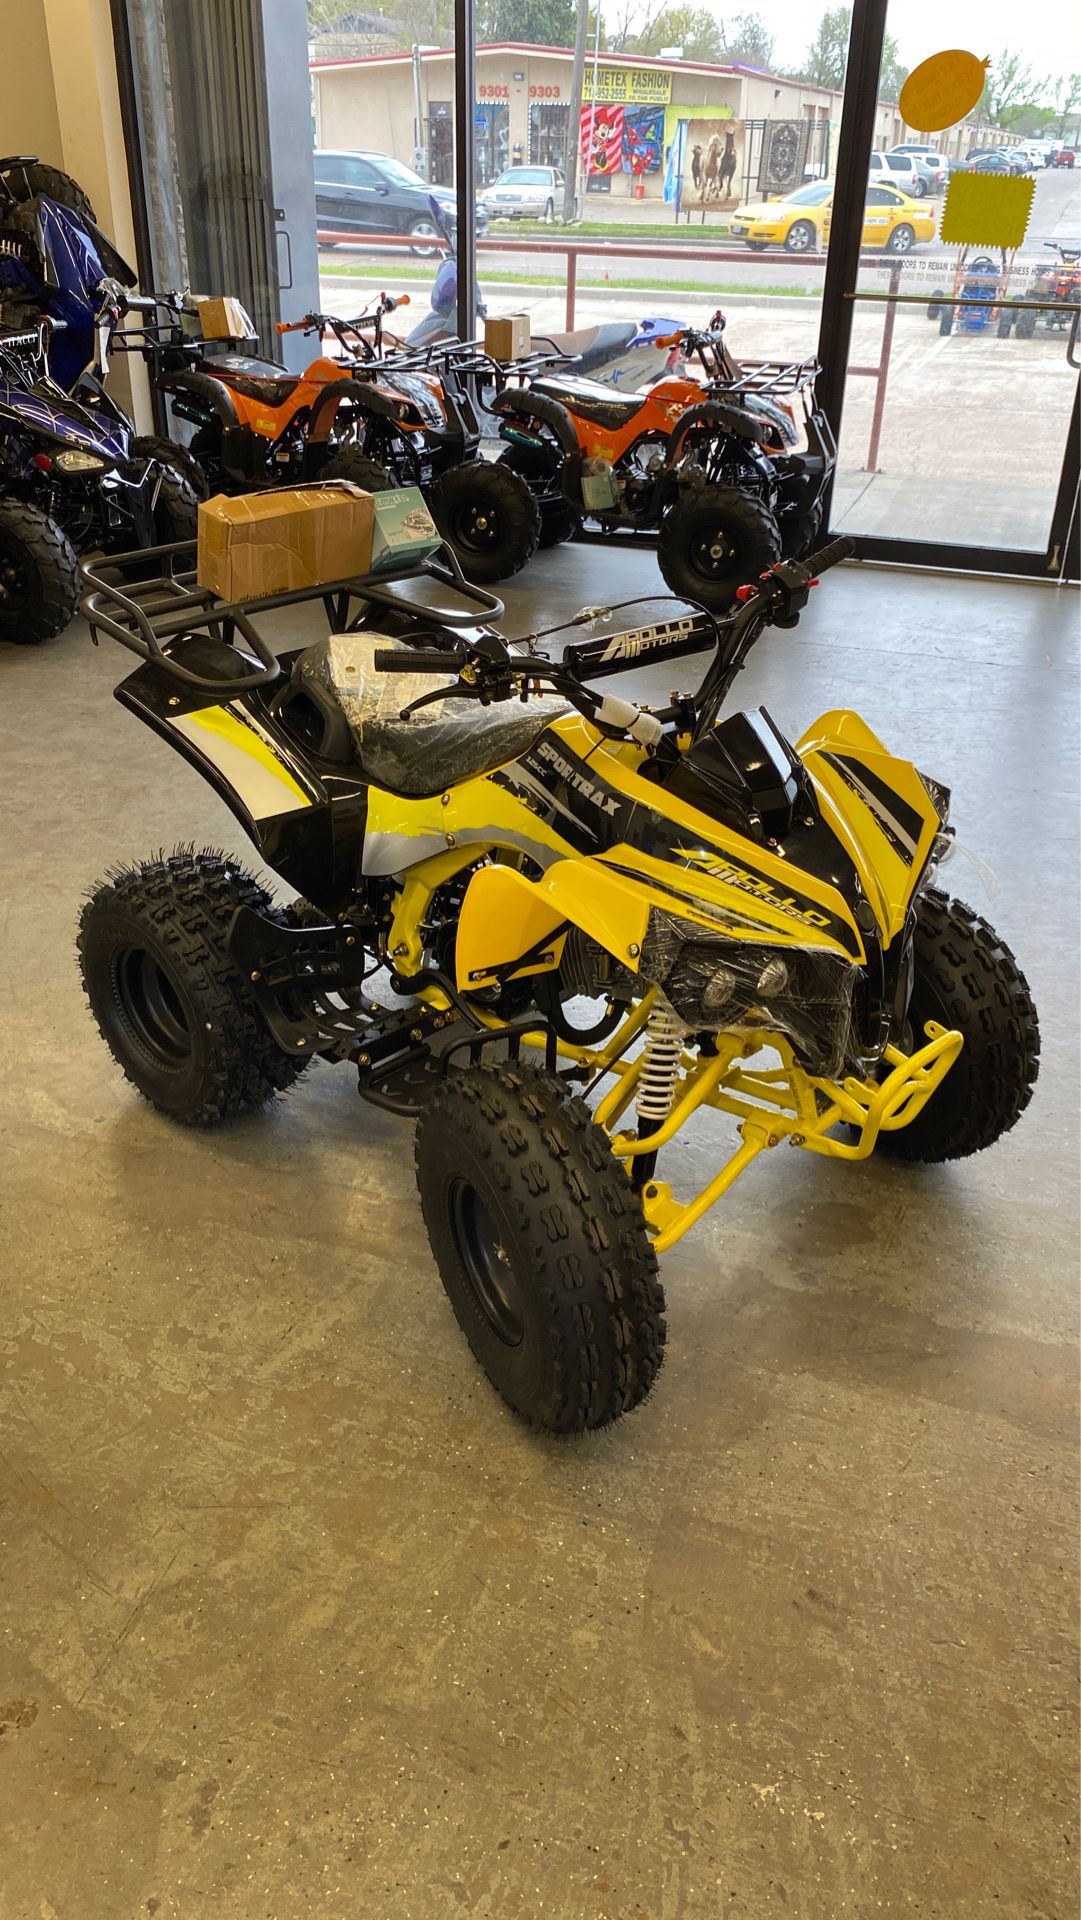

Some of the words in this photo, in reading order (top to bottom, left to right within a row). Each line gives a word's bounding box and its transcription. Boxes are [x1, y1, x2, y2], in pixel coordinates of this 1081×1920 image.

[631, 71, 669, 89] FASHION
[479, 85, 509, 98] 9301
[529, 86, 560, 98] 9303
[584, 87, 627, 100] 71-952-2555
[919, 261, 927, 270] TO
[927, 261, 949, 271] REMAIN
[599, 618, 694, 662] APOLLO
[536, 741, 622, 817] SPORTRAX
[669, 847, 832, 927] APOLLO
